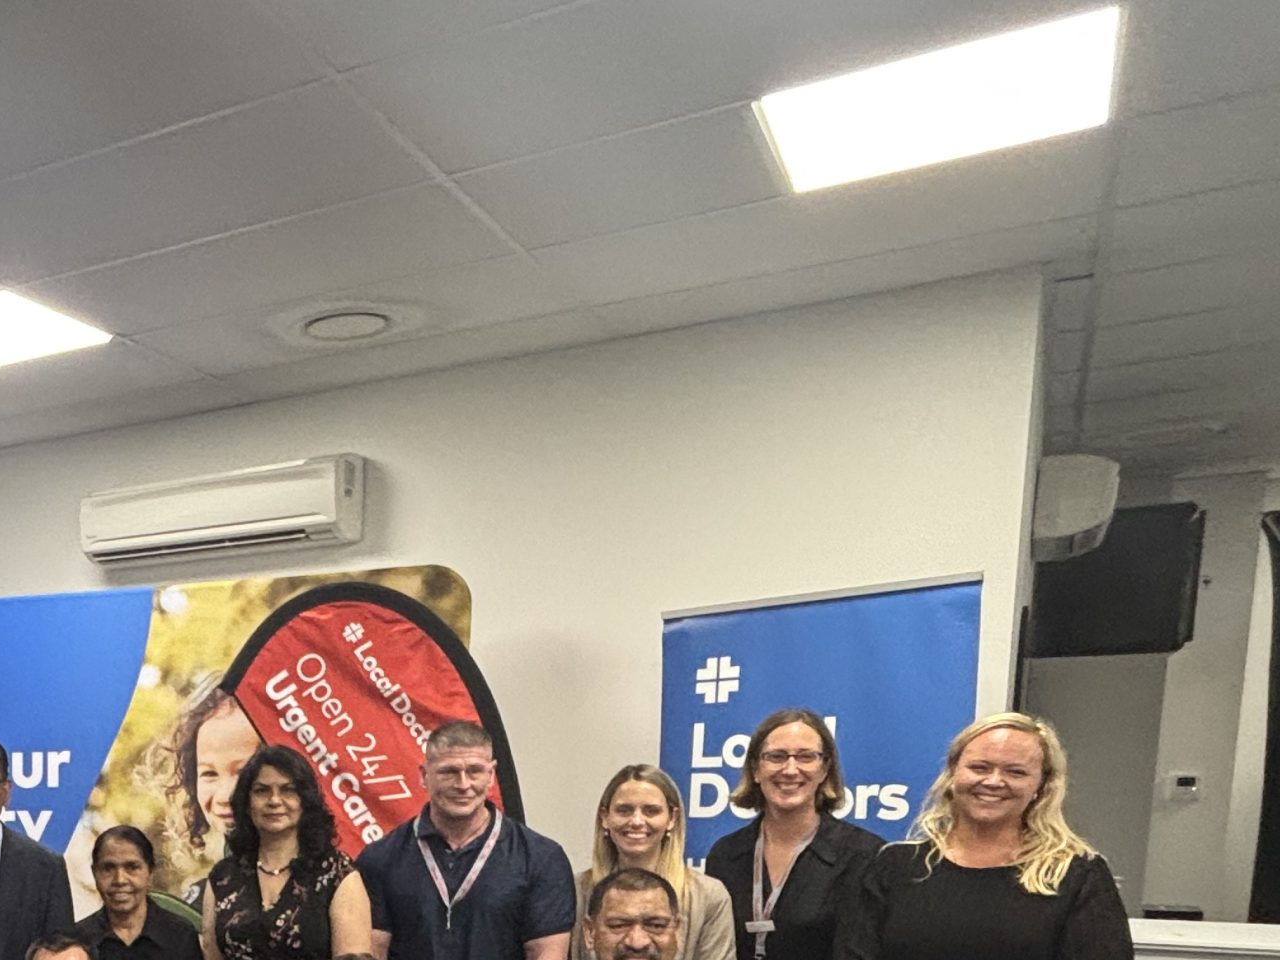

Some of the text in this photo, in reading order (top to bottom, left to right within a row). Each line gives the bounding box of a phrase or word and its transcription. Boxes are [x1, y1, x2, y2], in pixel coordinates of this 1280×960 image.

[265, 669, 384, 845] Urgent Care
[296, 653, 412, 801] Open 24/7
[353, 640, 432, 754] Local Doct
[11, 750, 71, 789] ur
